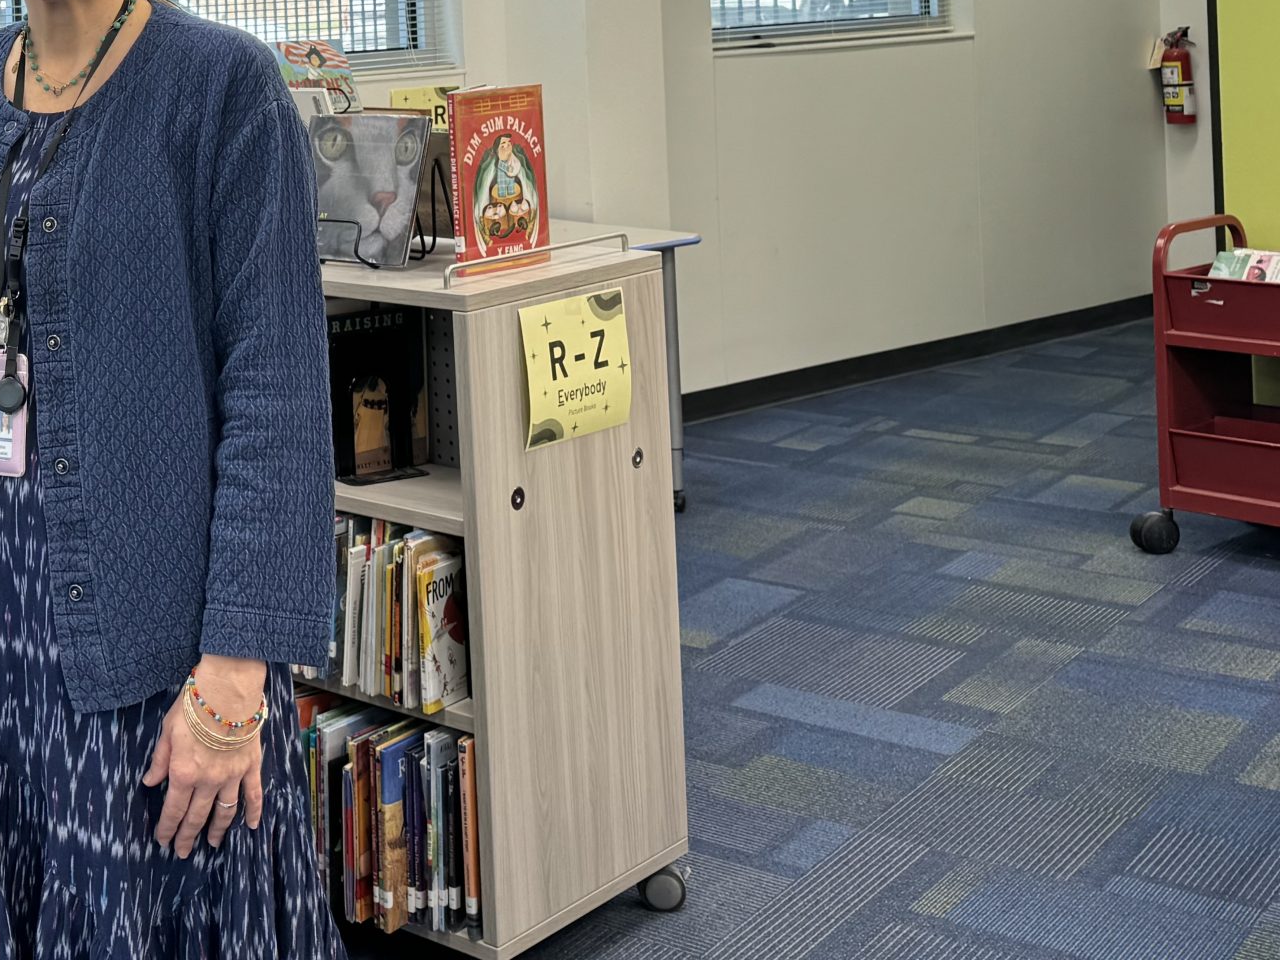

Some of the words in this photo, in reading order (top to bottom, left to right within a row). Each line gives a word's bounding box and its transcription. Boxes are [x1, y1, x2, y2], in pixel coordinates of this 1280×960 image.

[464, 132, 482, 166] DIM
[481, 116, 504, 137] SUM
[507, 116, 542, 157] PALACE
[332, 312, 404, 334] RAISING
[558, 379, 607, 407] Everybody
[426, 573, 454, 606] FROM
